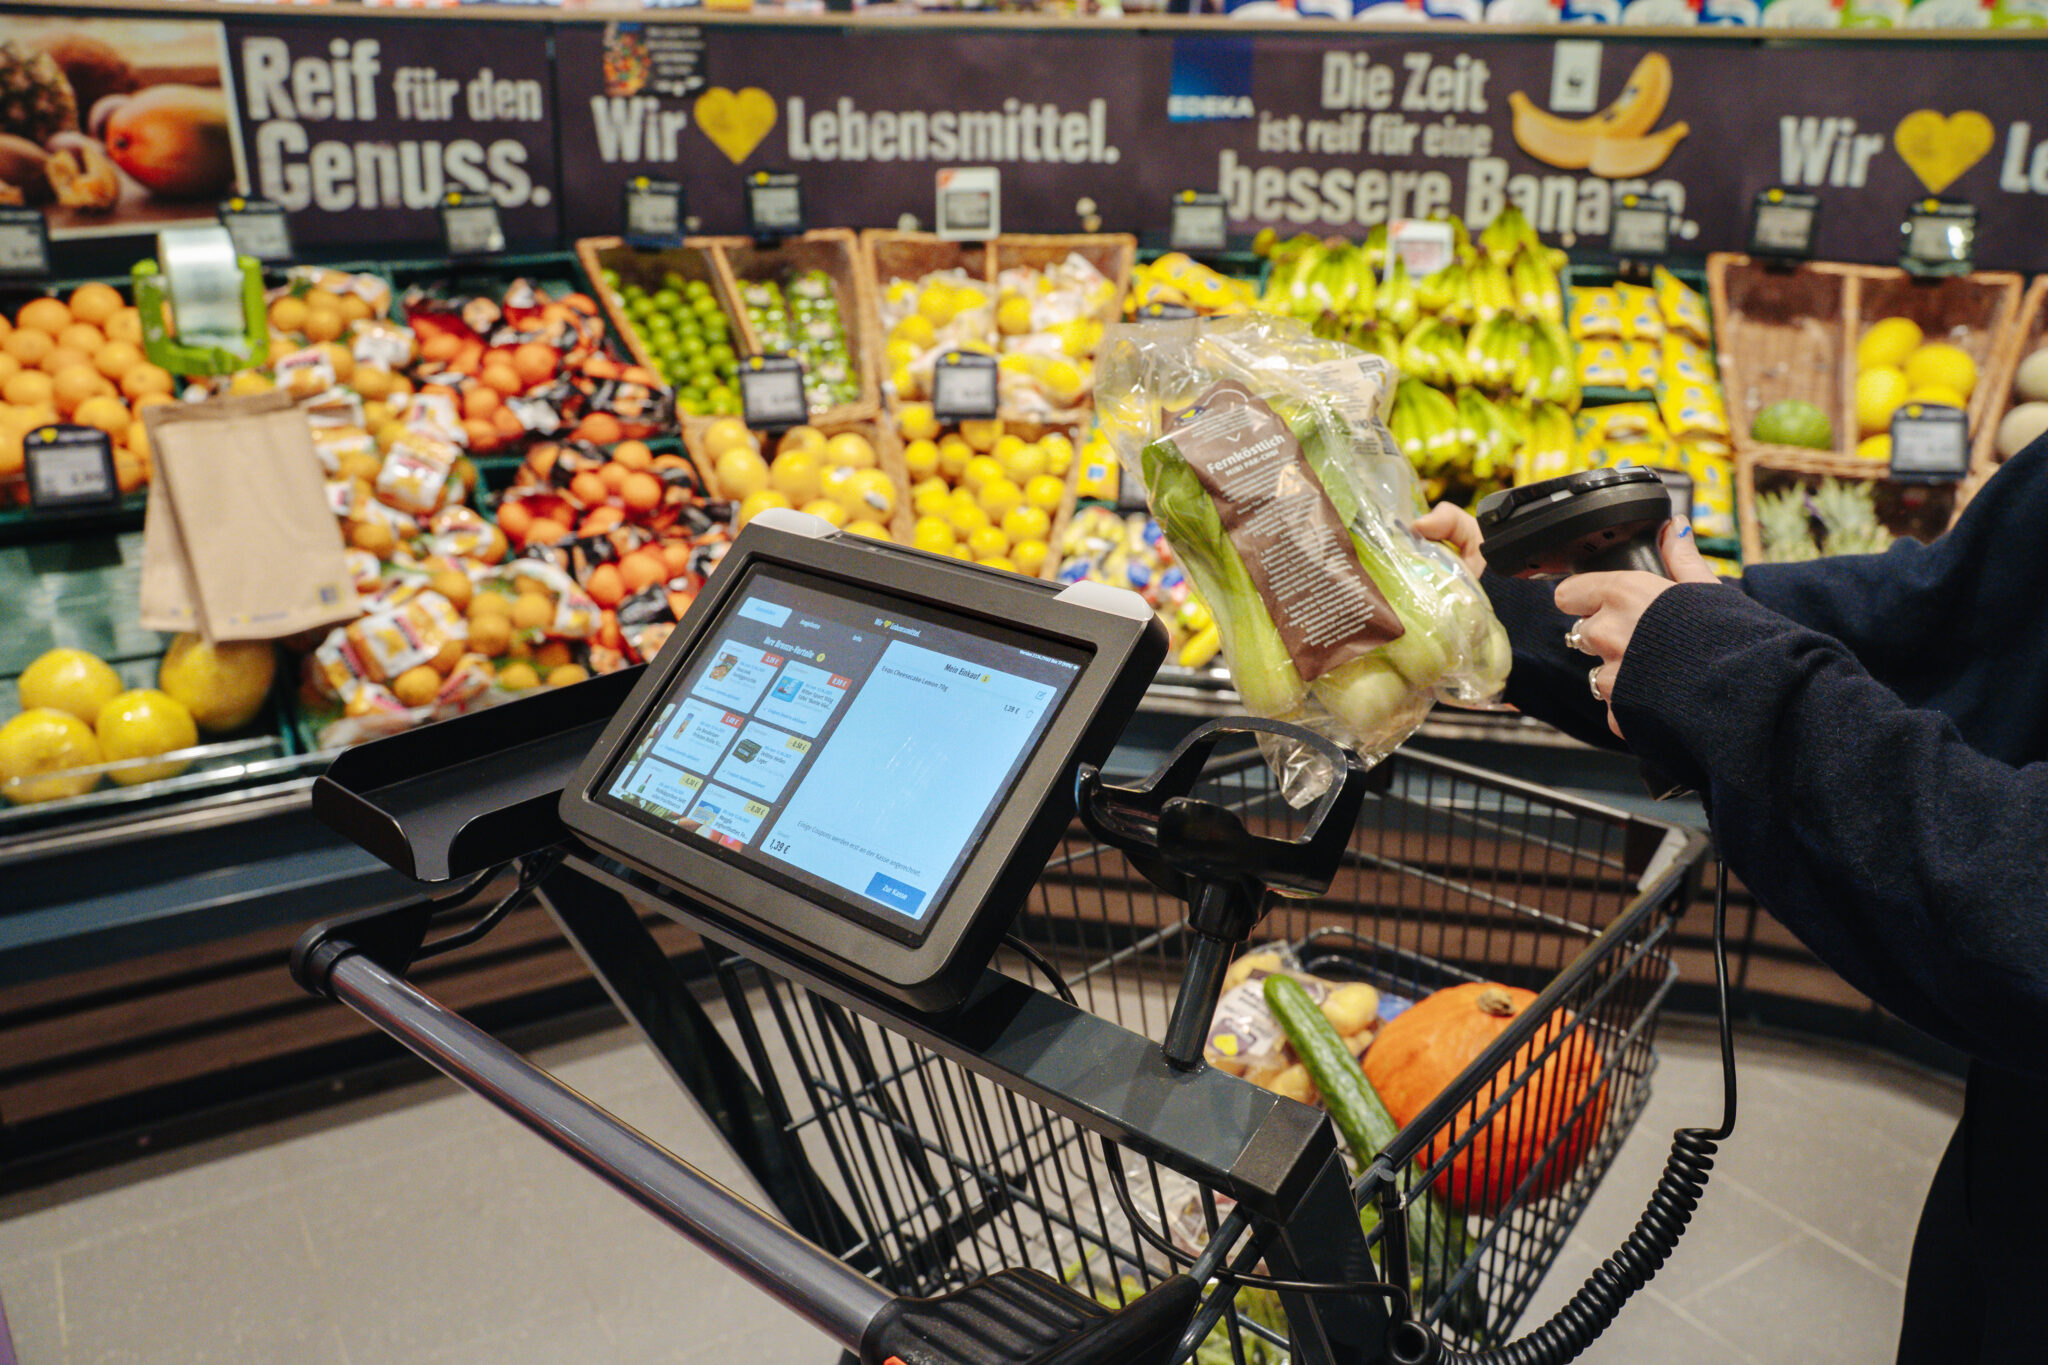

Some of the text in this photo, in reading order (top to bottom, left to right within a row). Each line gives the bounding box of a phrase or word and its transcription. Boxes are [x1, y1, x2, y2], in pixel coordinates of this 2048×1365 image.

[242, 36, 542, 121] Reif für den
[1322, 51, 1490, 113] Die Zeit
[592, 96, 1120, 165] Wir Lebensmittel.
[1259, 112, 1493, 157] ist reif für eine
[1779, 116, 1885, 188] Wir
[257, 121, 550, 212] Genuss.
[1219, 150, 1451, 225] bessere
[1207, 434, 1286, 474] Fernköstlich
[944, 664, 959, 673] Mein
[958, 668, 981, 680] Einkauf
[769, 839, 785, 852] 1,39
[892, 889, 908, 900] Kasse
